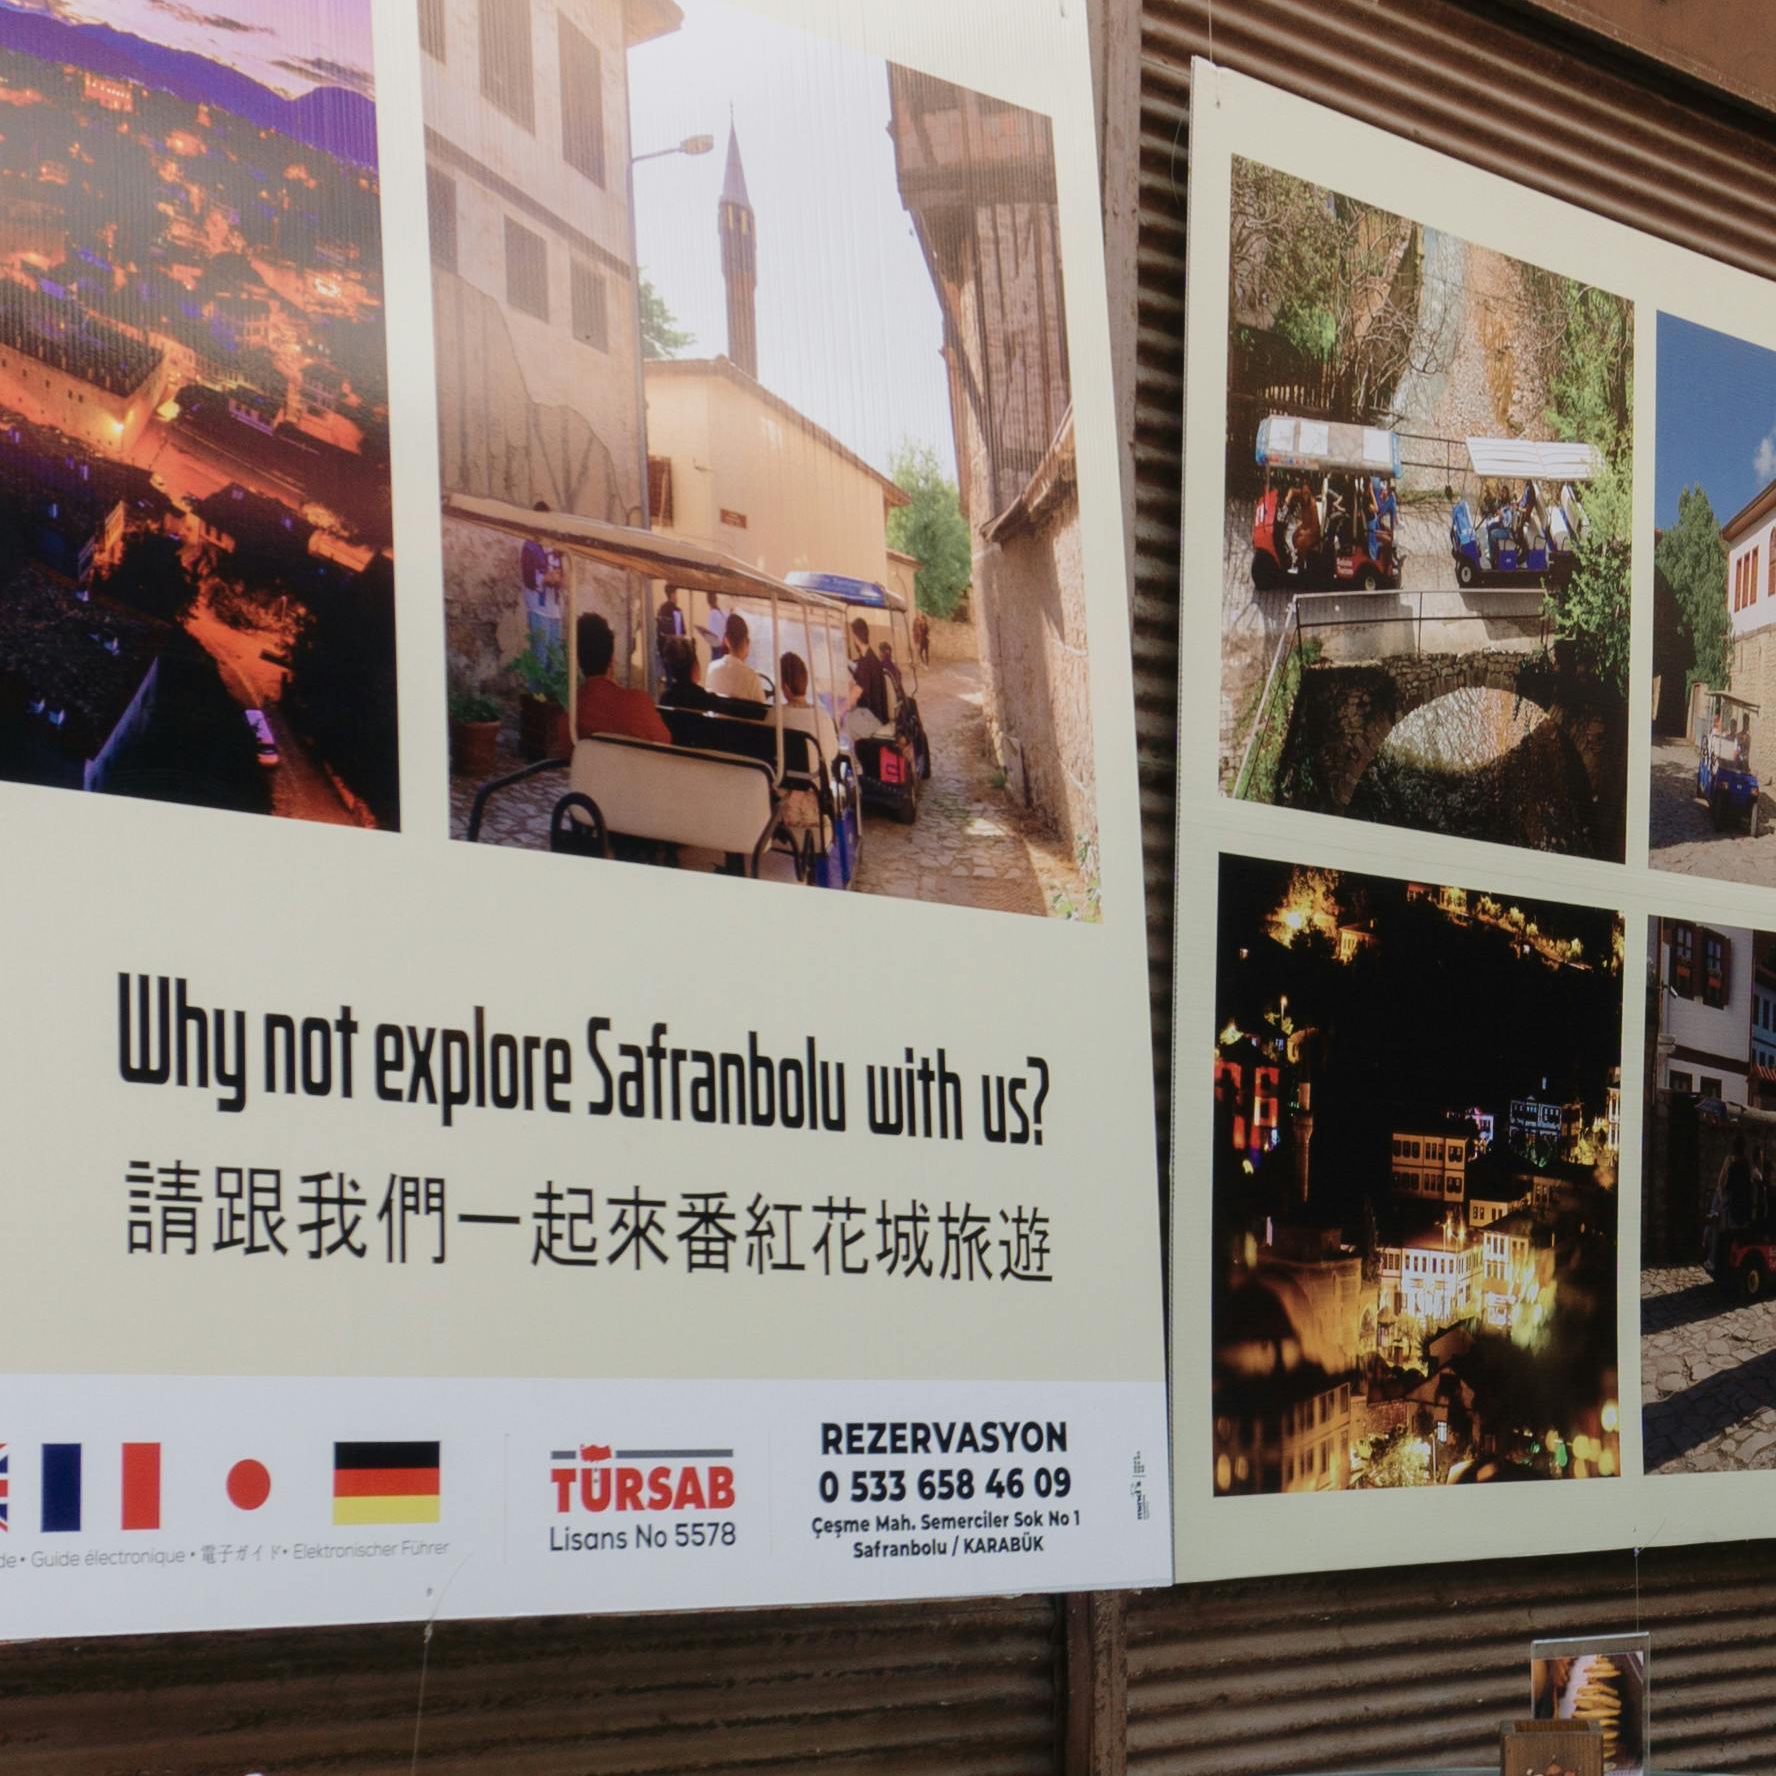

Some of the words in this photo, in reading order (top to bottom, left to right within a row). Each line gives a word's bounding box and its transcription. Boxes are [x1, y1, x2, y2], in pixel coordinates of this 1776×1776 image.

[118, 972, 247, 1113] Why
[264, 1005, 359, 1099] not
[375, 1005, 572, 1127] explore
[587, 1016, 847, 1132] Safranbolu
[866, 1047, 963, 1141] with
[981, 1056, 1050, 1146] us?
[125, 1159, 1053, 1283] 請跟我們一起來番紅花城旅遊
[821, 1421, 1067, 1455] REZERVASYON
[551, 1466, 735, 1513] TÜRSAB
[819, 1470, 839, 1503] 0
[850, 1470, 907, 1503] 533
[917, 1468, 975, 1501] 658
[985, 1467, 1025, 1499] 46
[1034, 1466, 1071, 1498] 09
[550, 1526, 628, 1552] Lisans
[635, 1524, 668, 1549] No
[675, 1521, 737, 1548] 5578
[811, 1517, 870, 1539] Çeşme
[876, 1514, 917, 1532] Mah.
[921, 1510, 1010, 1531] Semerciler
[1014, 1510, 1044, 1527] Sok
[1048, 1509, 1070, 1526] No
[1073, 1509, 1080, 1526] 1
[30, 1551, 81, 1568] Guide
[84, 1548, 186, 1567] électronique
[293, 1542, 399, 1560] Elektronischer
[401, 1539, 450, 1556] Führer
[853, 1539, 947, 1559] Safranbolu
[963, 1531, 1044, 1554] KARABÜK
